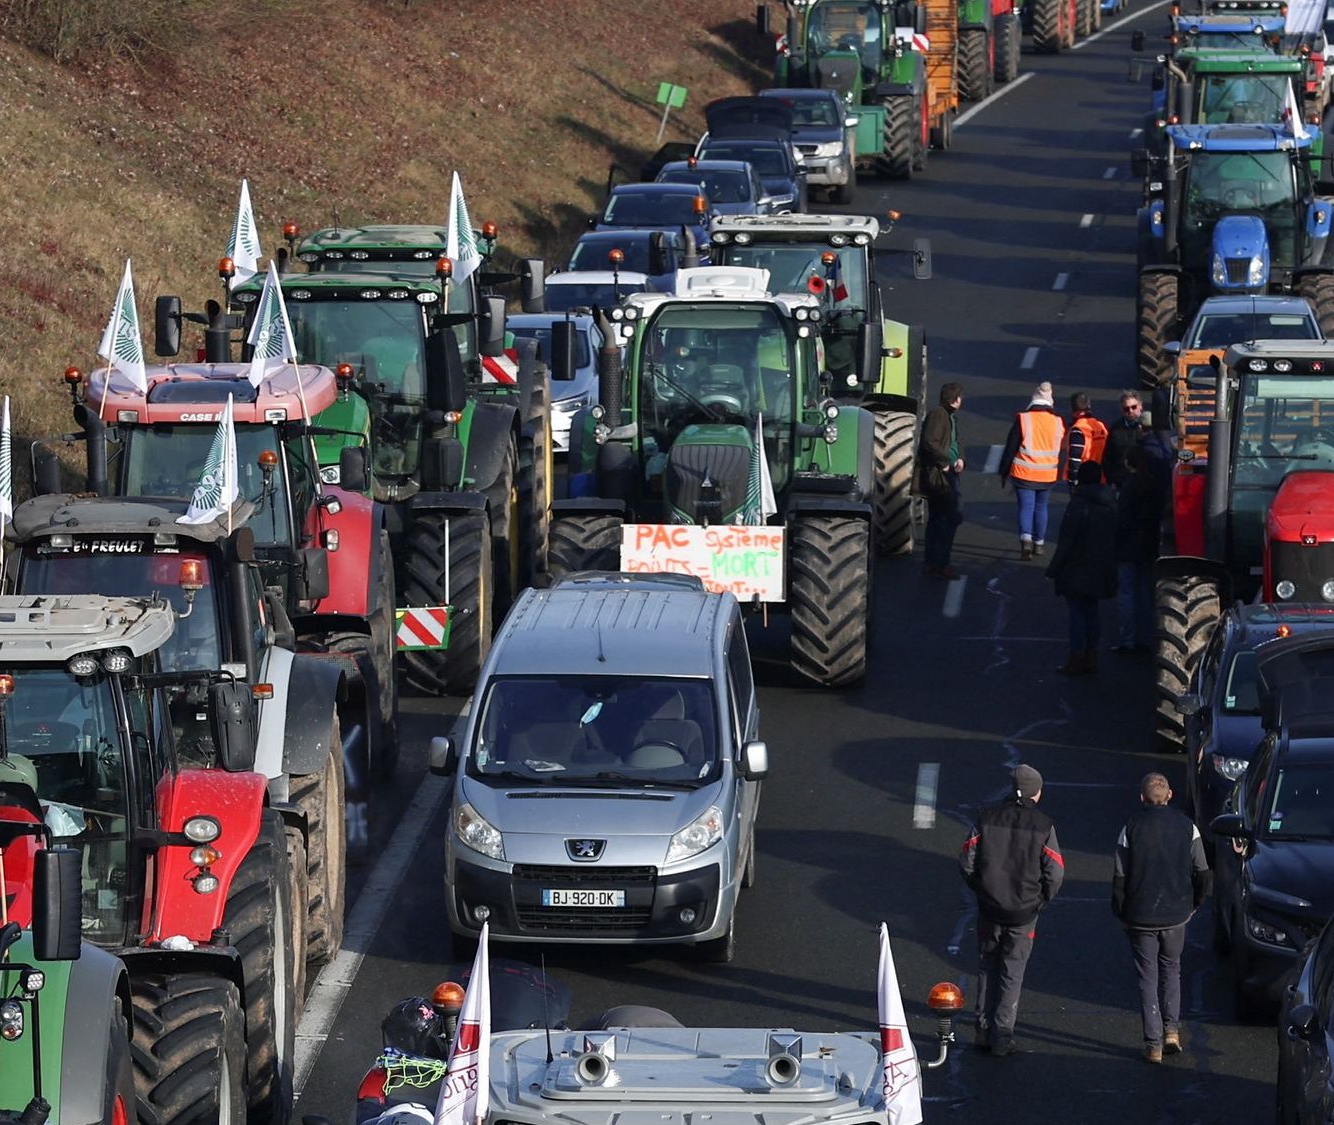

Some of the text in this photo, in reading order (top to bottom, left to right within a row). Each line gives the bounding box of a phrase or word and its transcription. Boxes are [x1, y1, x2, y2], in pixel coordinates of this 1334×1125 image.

[179, 413, 213, 422] CASE
[635, 525, 691, 551] PAC
[91, 540, 145, 553] FREULET
[712, 551, 779, 579] MORT
[552, 891, 615, 906] BJ-920-DK
